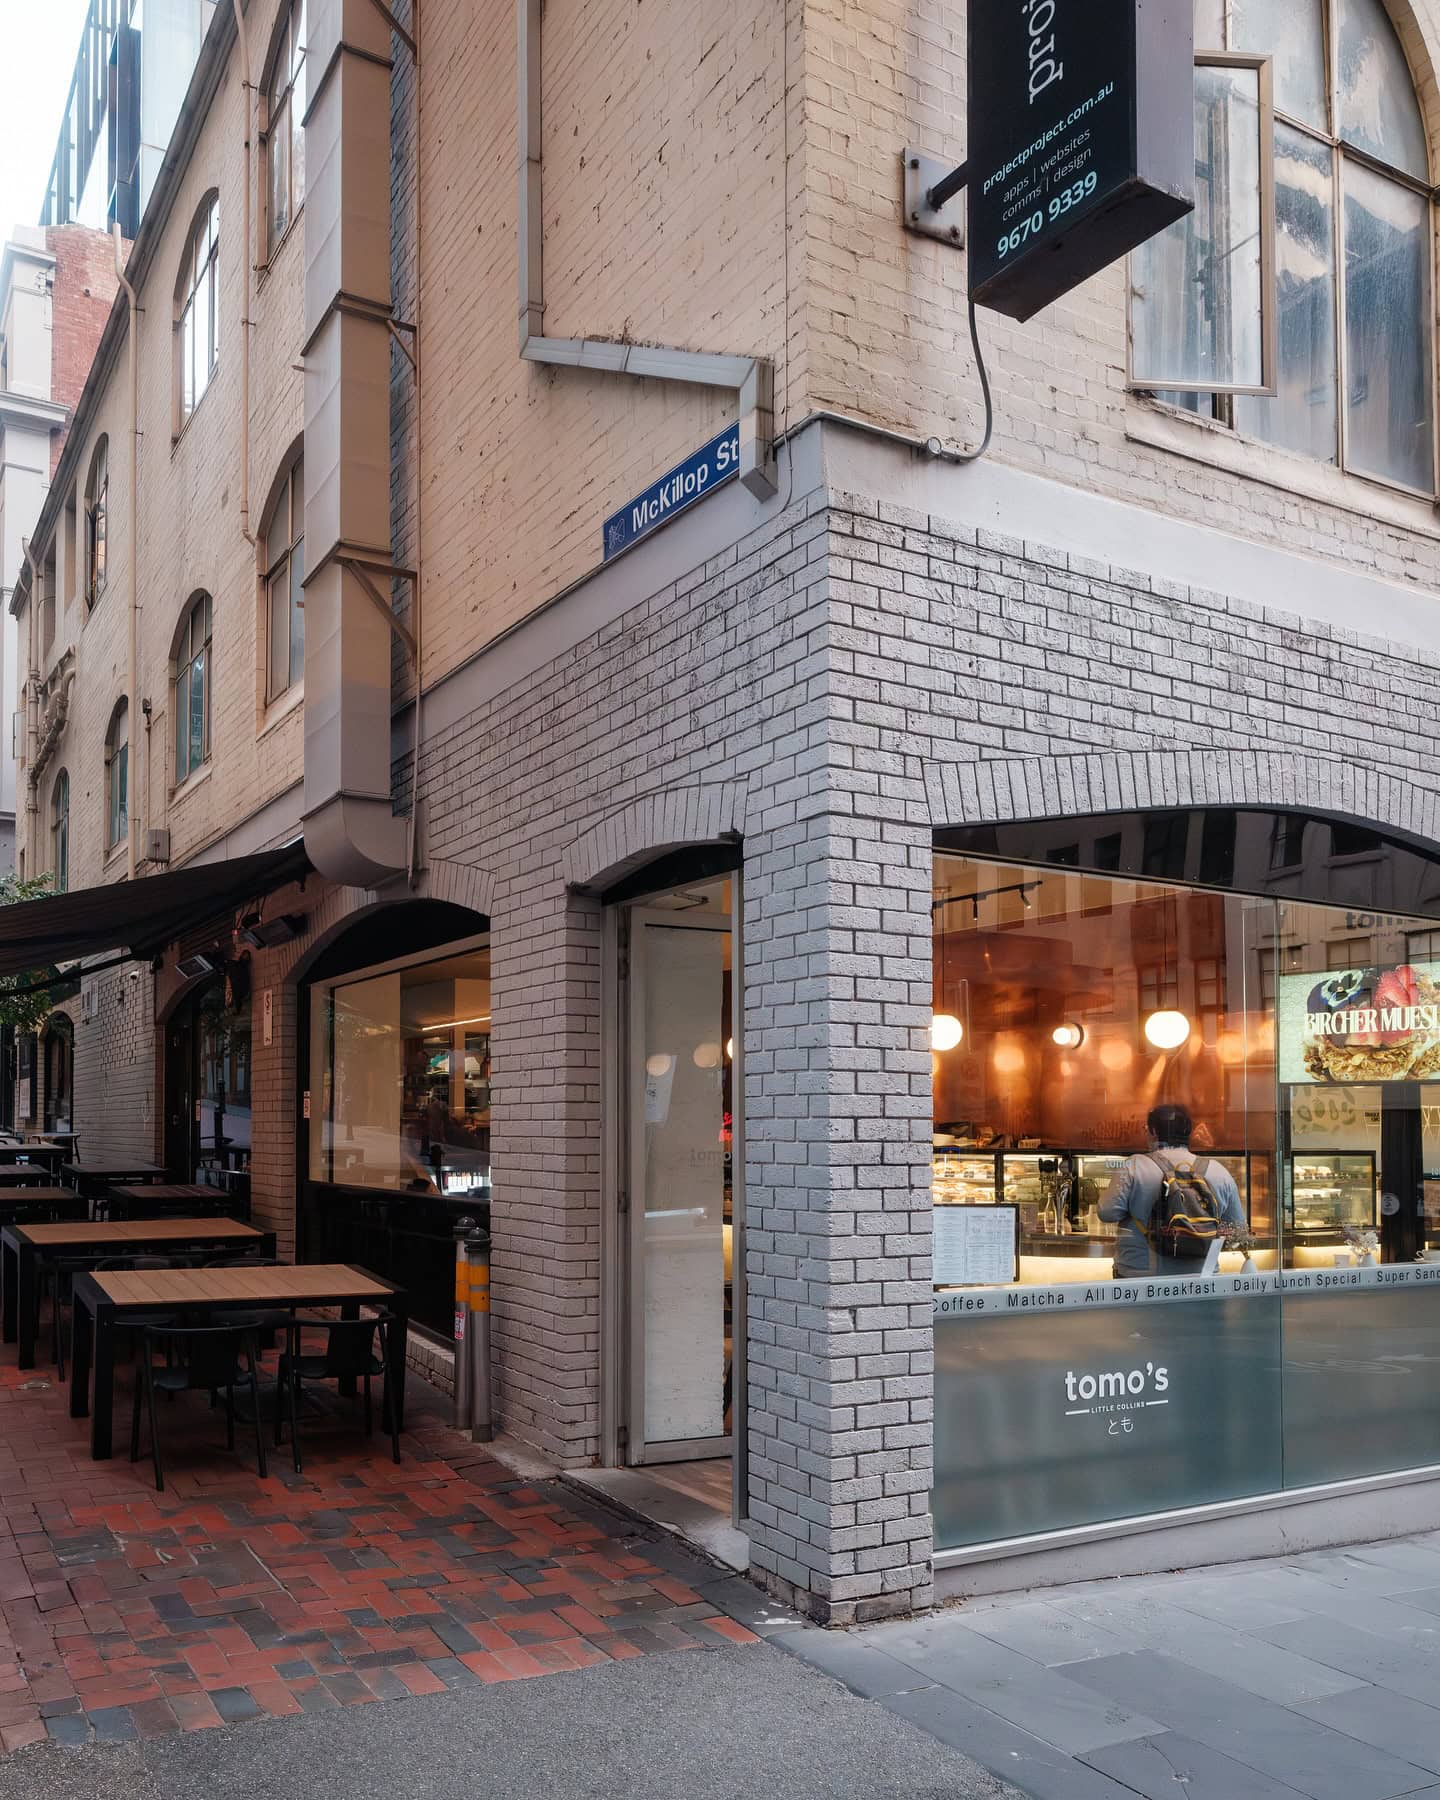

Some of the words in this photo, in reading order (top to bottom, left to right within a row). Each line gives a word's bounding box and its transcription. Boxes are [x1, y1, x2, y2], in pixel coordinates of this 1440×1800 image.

[983, 81, 1114, 195] projectproject.com.au
[1003, 176, 1029, 203] apps
[1040, 128, 1091, 173] websites
[1002, 185, 1042, 221] comms
[1053, 147, 1092, 183] design
[997, 210, 1043, 259] 9670
[1048, 171, 1098, 222] 9339
[632, 463, 709, 533] McKillop
[716, 437, 739, 471] St
[1304, 1008, 1379, 1035] BIRCHER
[1008, 1292, 1065, 1308] Matcha
[1085, 1288, 1106, 1302] All
[1113, 1286, 1139, 1301] Day
[1147, 1279, 1216, 1298] Breakfast
[1233, 1277, 1267, 1293] Daily
[1274, 1274, 1311, 1290] Lunch
[1316, 1271, 1361, 1288] Special
[1376, 1270, 1410, 1283] Super
[1065, 1361, 1169, 1401] tomo's
[1091, 1404, 1115, 1413] LITTLE
[1116, 1401, 1145, 1411] COLLINS
[1108, 1416, 1134, 1435] とも
